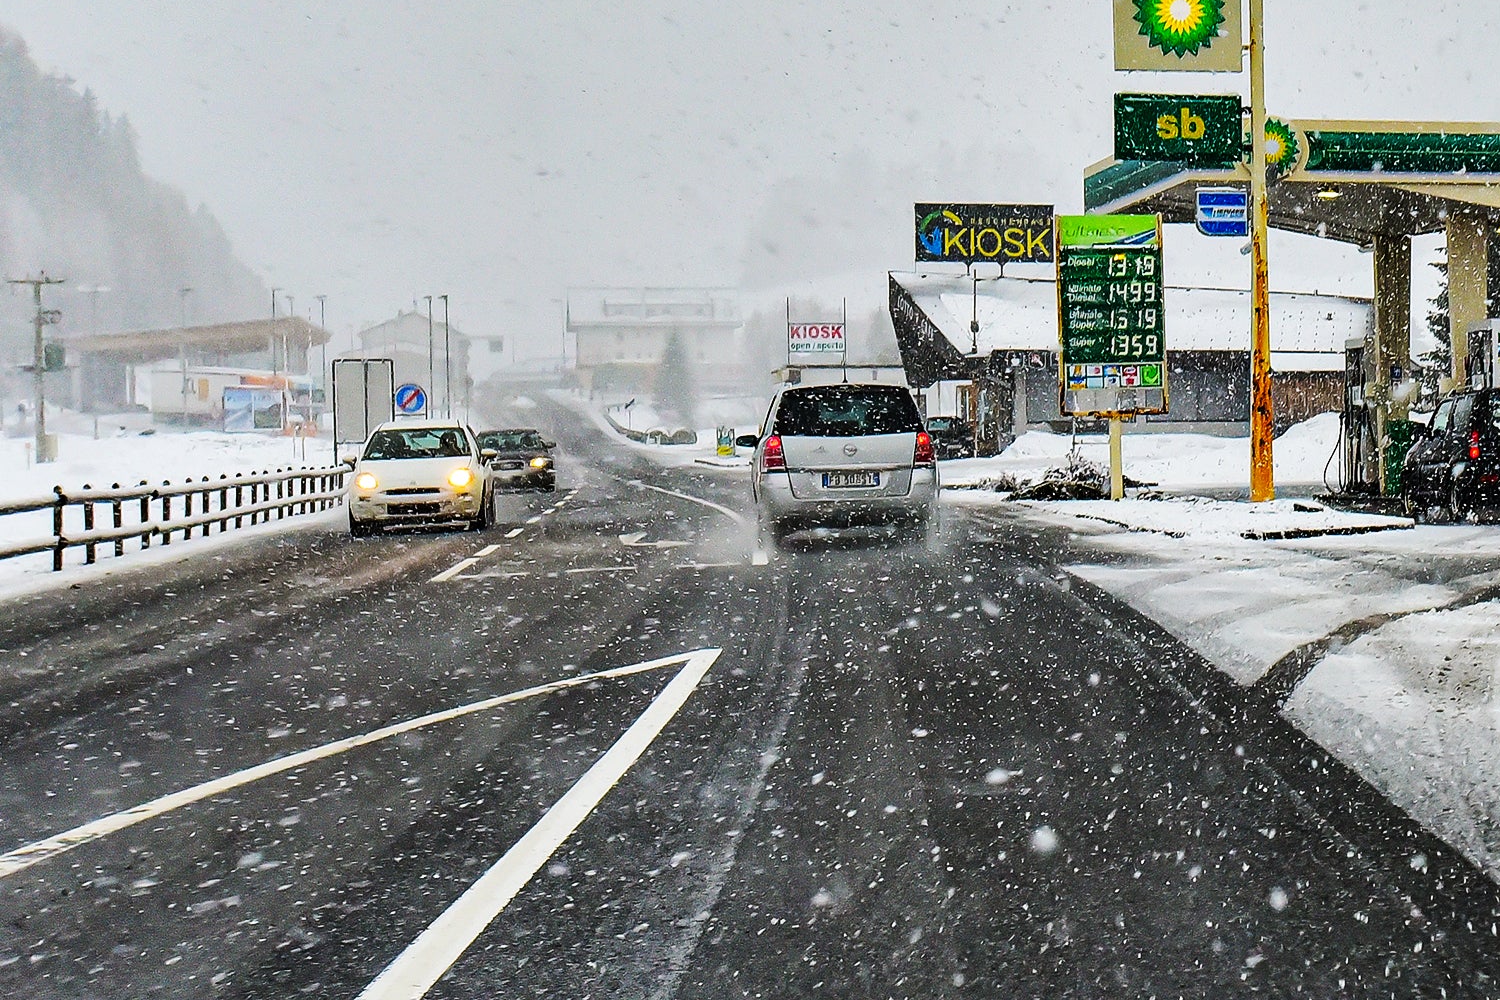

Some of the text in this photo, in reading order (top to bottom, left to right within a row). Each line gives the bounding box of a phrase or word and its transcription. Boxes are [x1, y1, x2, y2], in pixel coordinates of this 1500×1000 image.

[1156, 107, 1206, 140] sb
[943, 227, 1051, 258] KIOSK
[790, 325, 843, 339] KIOSK
